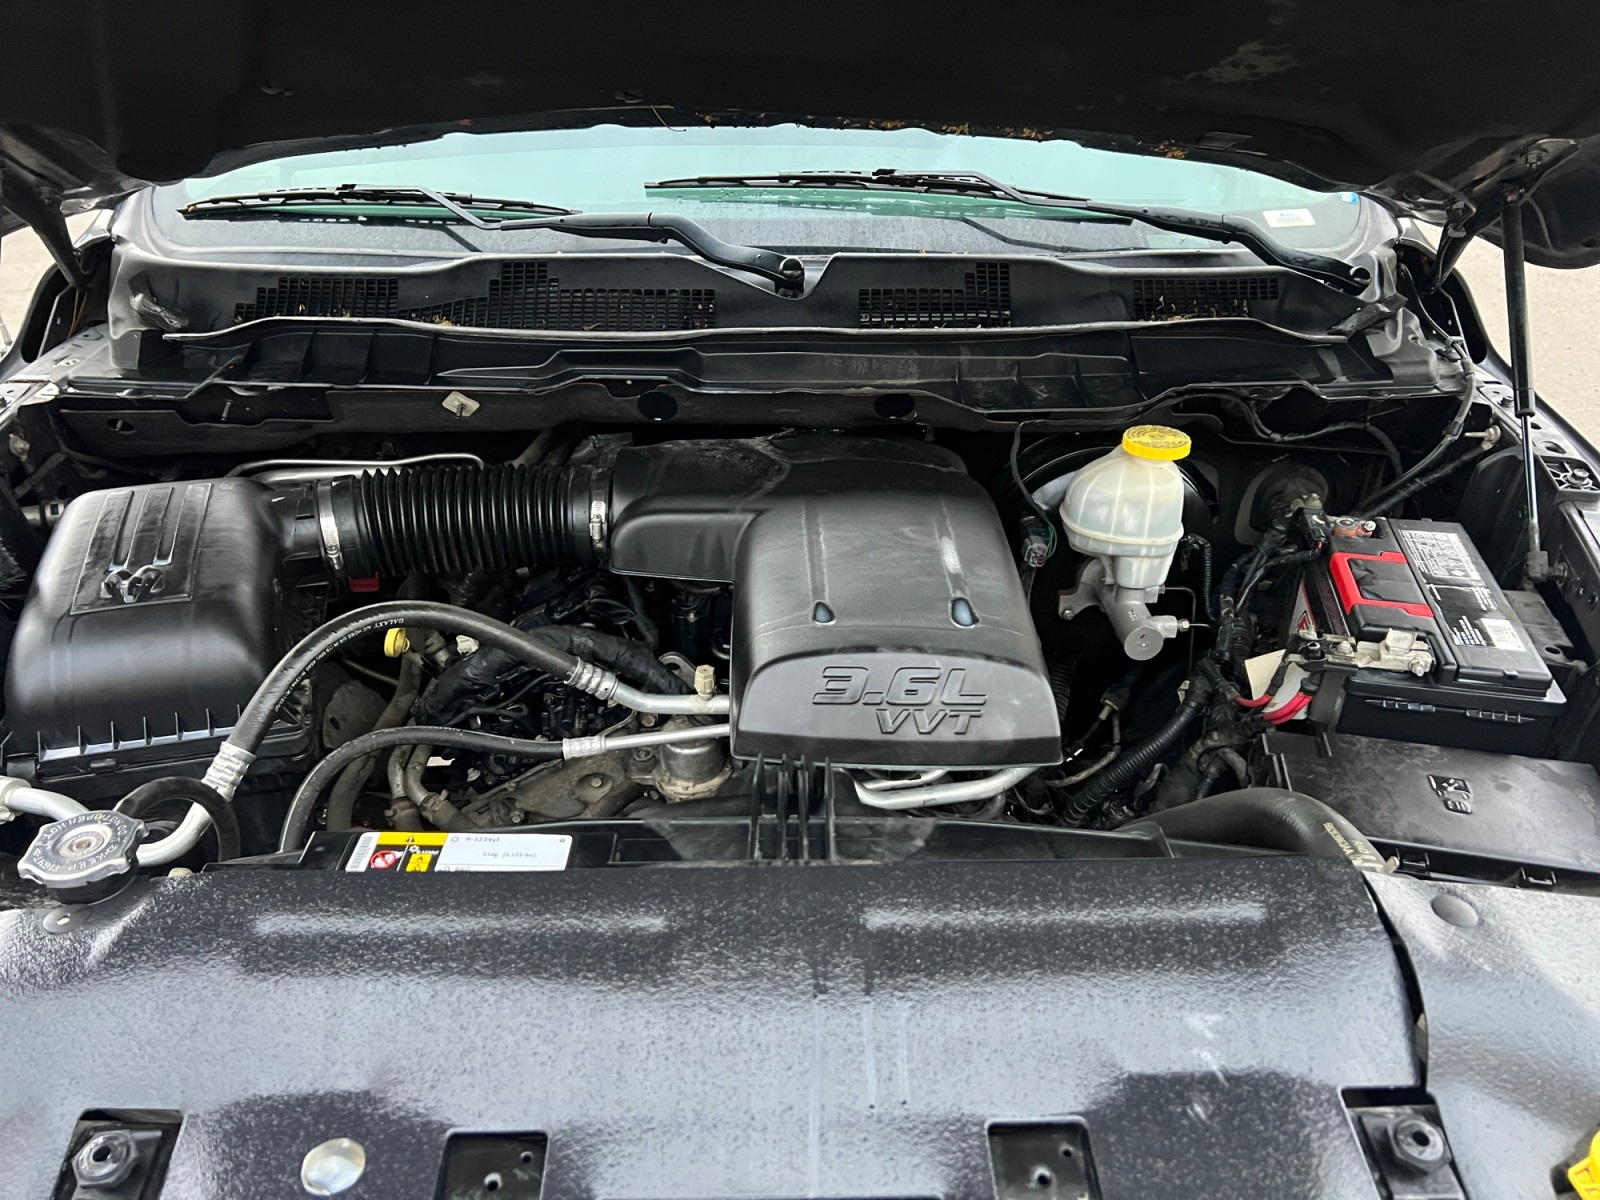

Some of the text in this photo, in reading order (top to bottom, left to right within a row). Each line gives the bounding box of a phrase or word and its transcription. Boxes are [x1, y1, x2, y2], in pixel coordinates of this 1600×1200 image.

[374, 618, 404, 628] GALAXY
[347, 629, 362, 639] HOSE
[812, 666, 987, 706] 3.6L
[876, 708, 984, 735] VVT
